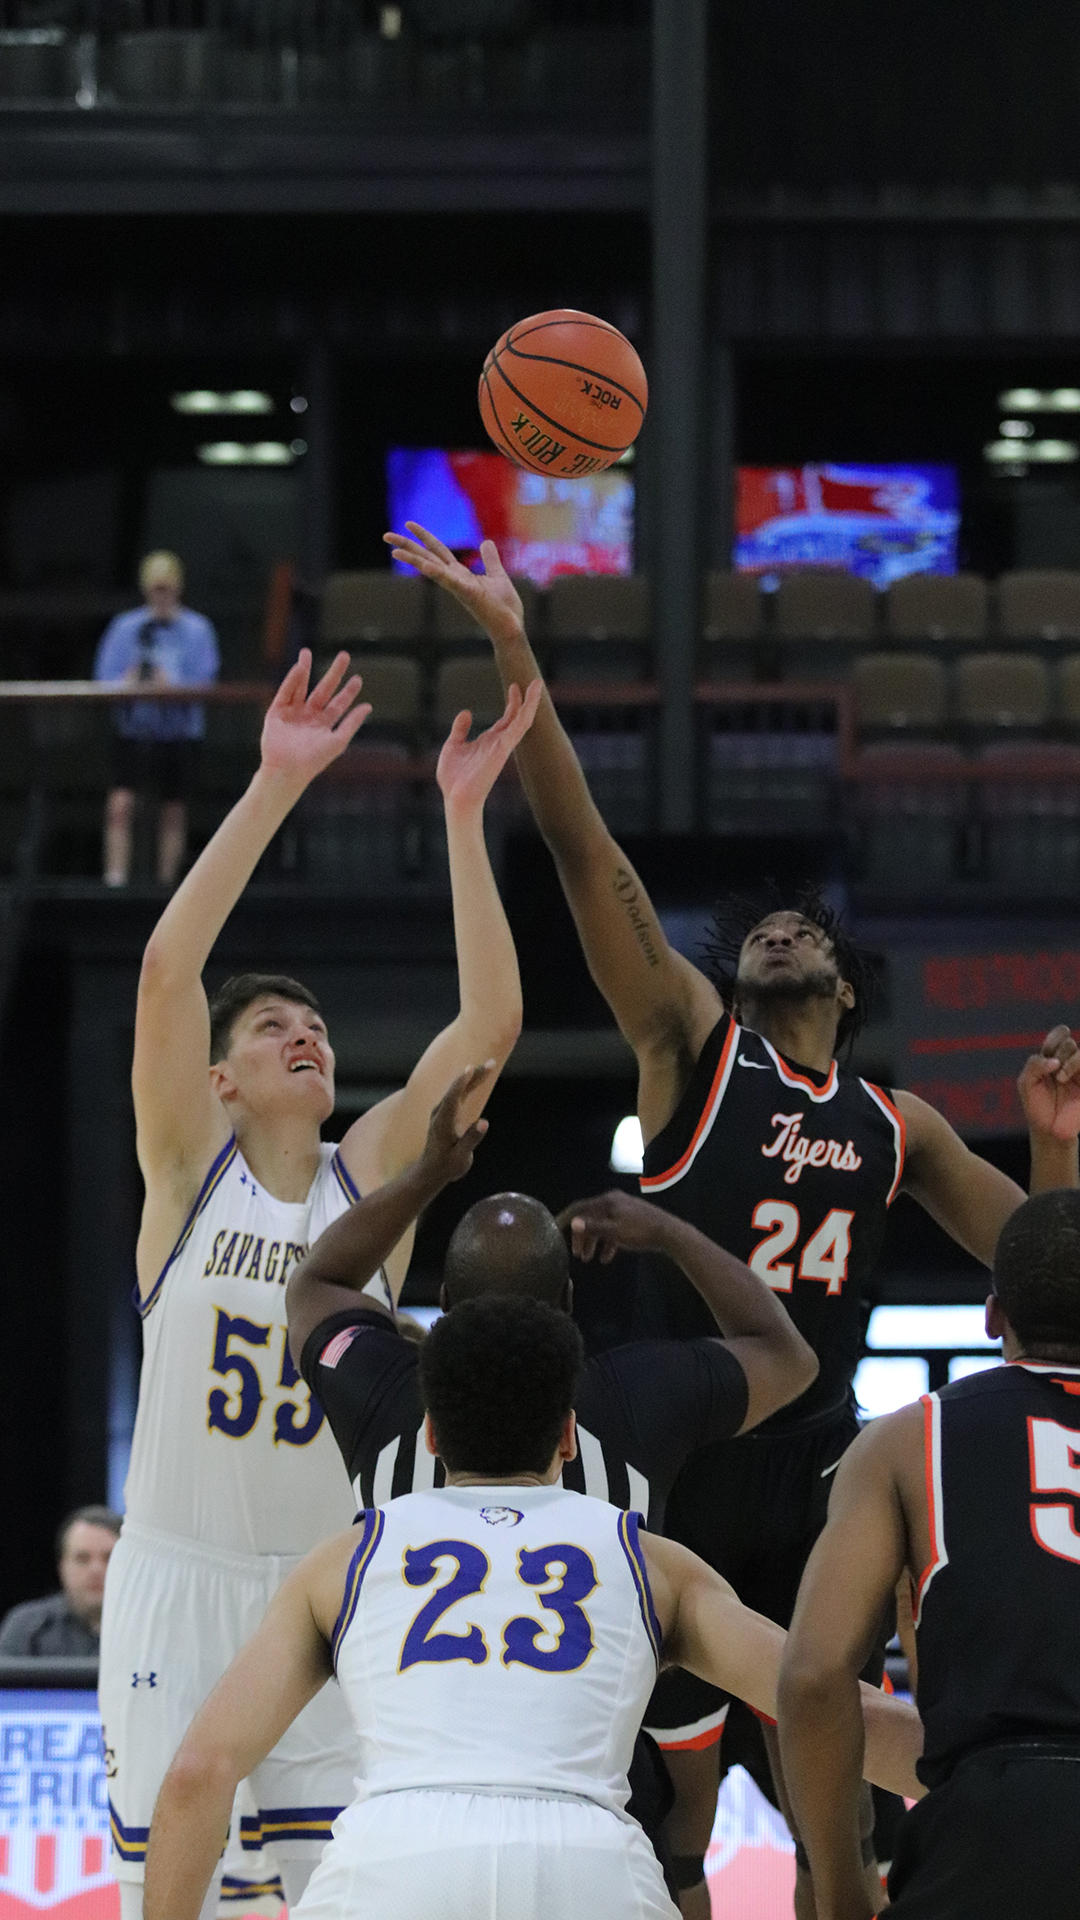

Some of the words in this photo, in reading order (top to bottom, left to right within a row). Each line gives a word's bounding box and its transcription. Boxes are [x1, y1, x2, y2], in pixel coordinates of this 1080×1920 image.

[580, 379, 622, 411] ROCK
[510, 412, 567, 466] ROCK
[612, 866, 660, 968] Dodson
[761, 1112, 862, 1184] Tigers
[747, 1198, 856, 1297] 24
[396, 1538, 602, 1676] 23
